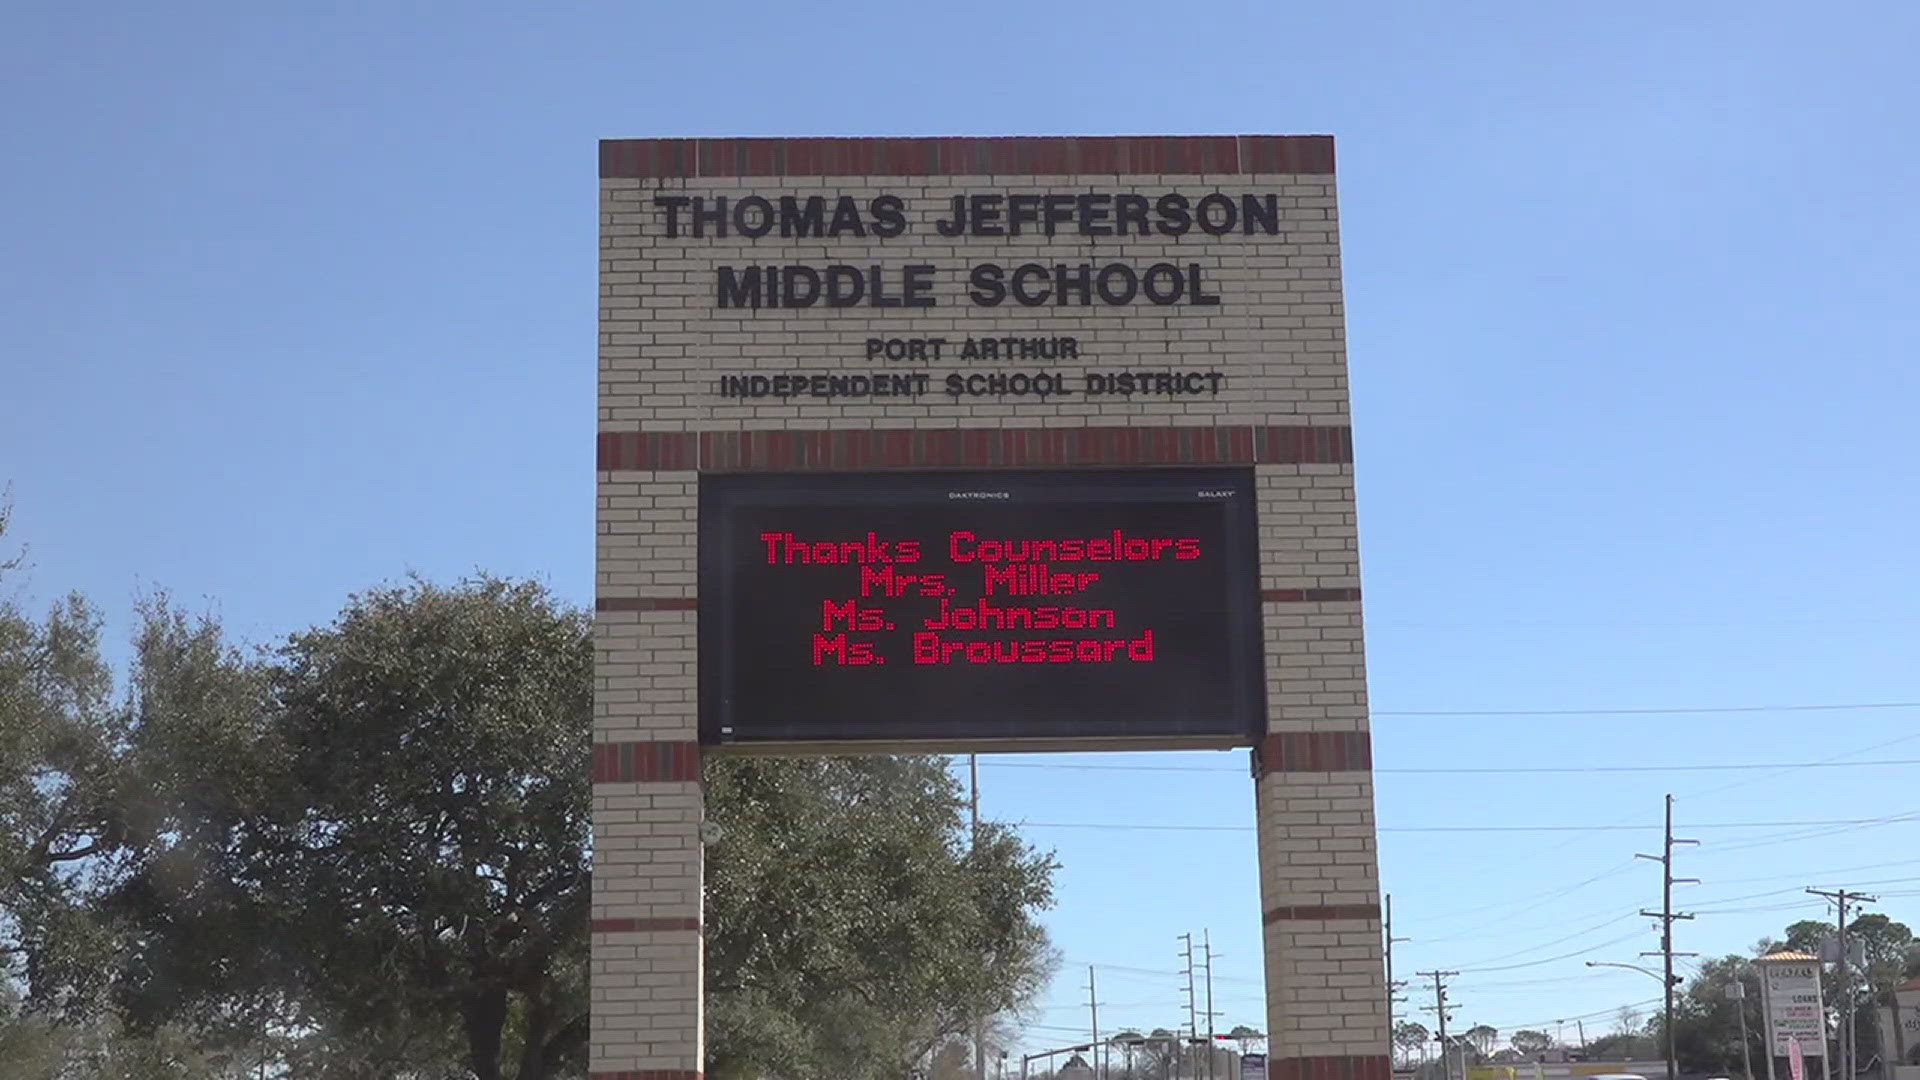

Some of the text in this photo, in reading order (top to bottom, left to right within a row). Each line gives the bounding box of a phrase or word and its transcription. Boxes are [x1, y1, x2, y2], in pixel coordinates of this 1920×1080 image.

[655, 193, 1279, 238] THOMAS JEFFERSON
[718, 263, 1220, 309] MIDDLE SCHOOL
[866, 337, 1078, 361] PORT ARTHUR
[721, 372, 1223, 398] INDEPENDENT SCHOOL DISTRICT
[761, 529, 1200, 564] Thanks Counselors
[860, 563, 1100, 597] Mrs. Miller
[824, 598, 1115, 632] Ms. Johnson
[813, 630, 1154, 666] Ms. Broussard
